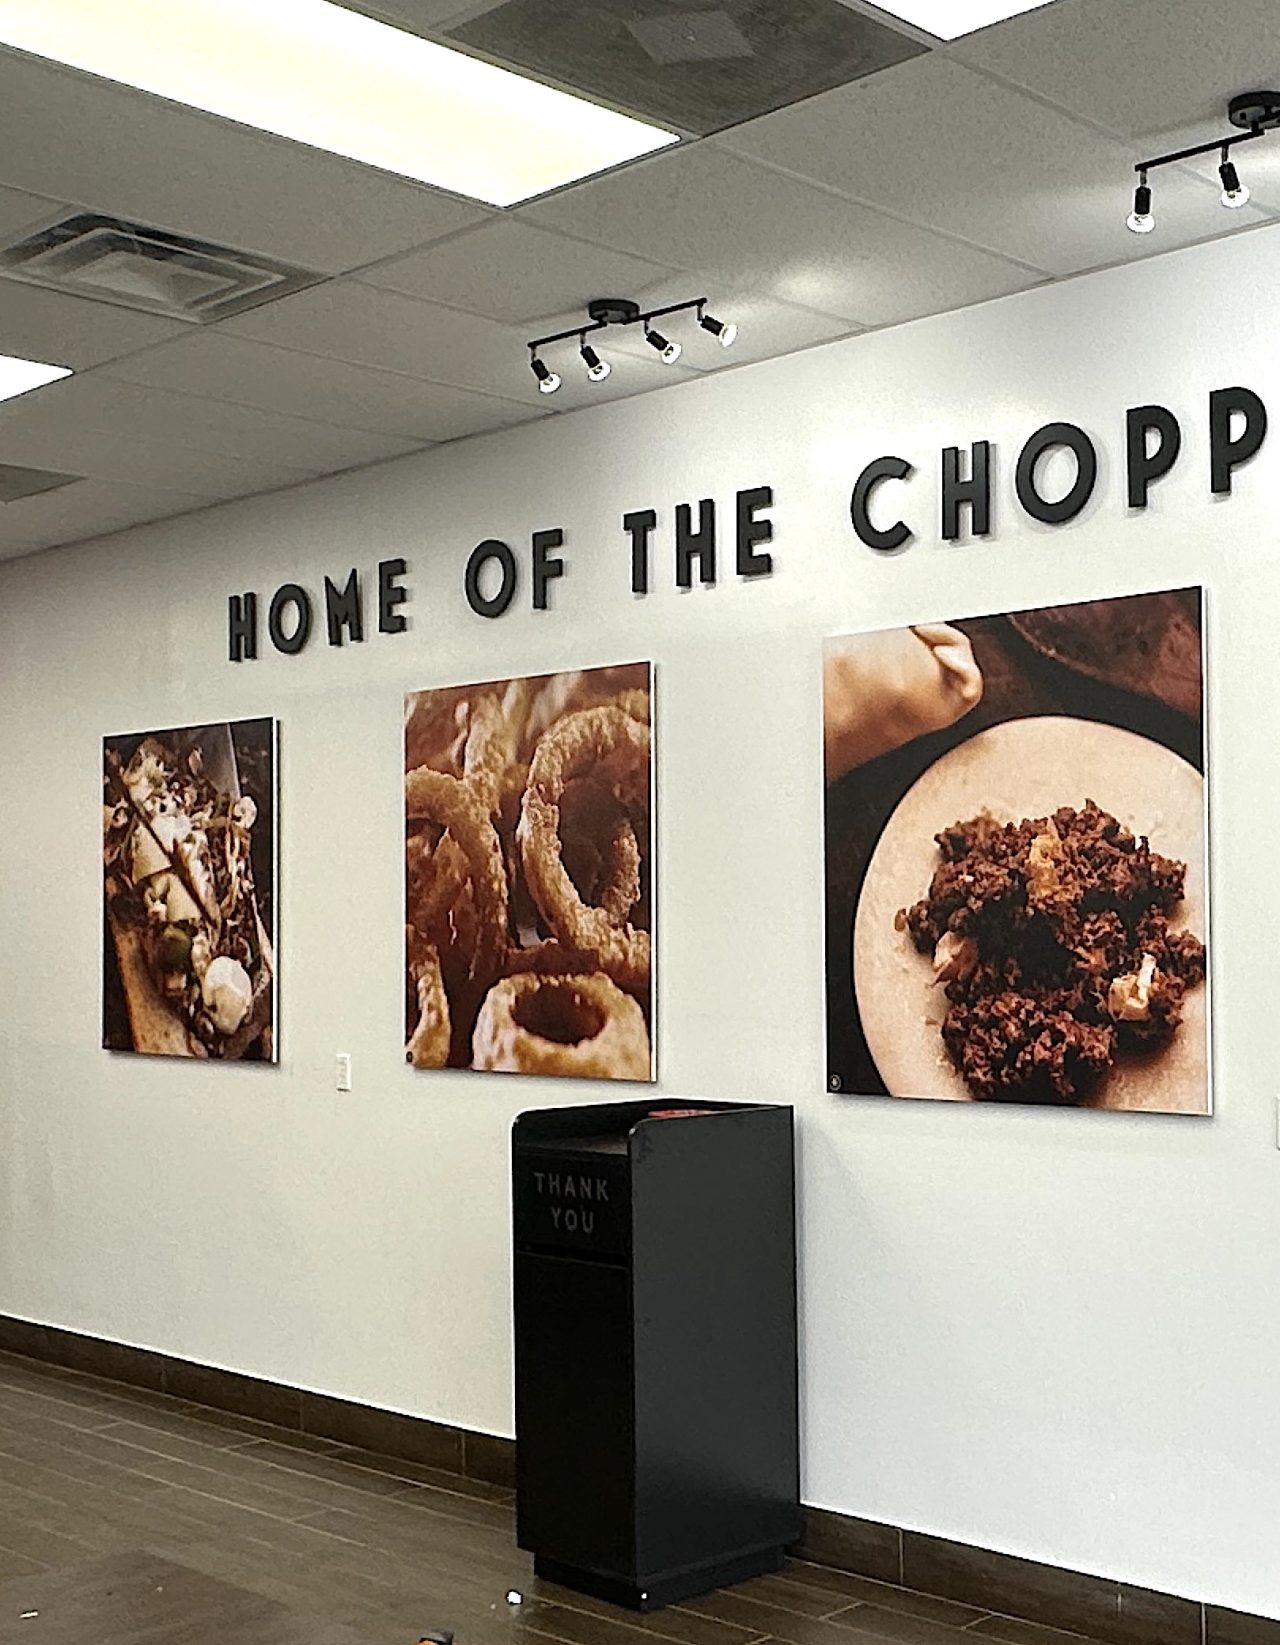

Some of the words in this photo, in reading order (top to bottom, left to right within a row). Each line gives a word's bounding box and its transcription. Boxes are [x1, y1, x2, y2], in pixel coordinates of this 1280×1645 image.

[228, 558, 408, 663] HOME
[465, 528, 564, 619] OF
[623, 485, 773, 595] THE
[533, 1172, 610, 1203] THANK
[550, 1206, 596, 1235] YOU
